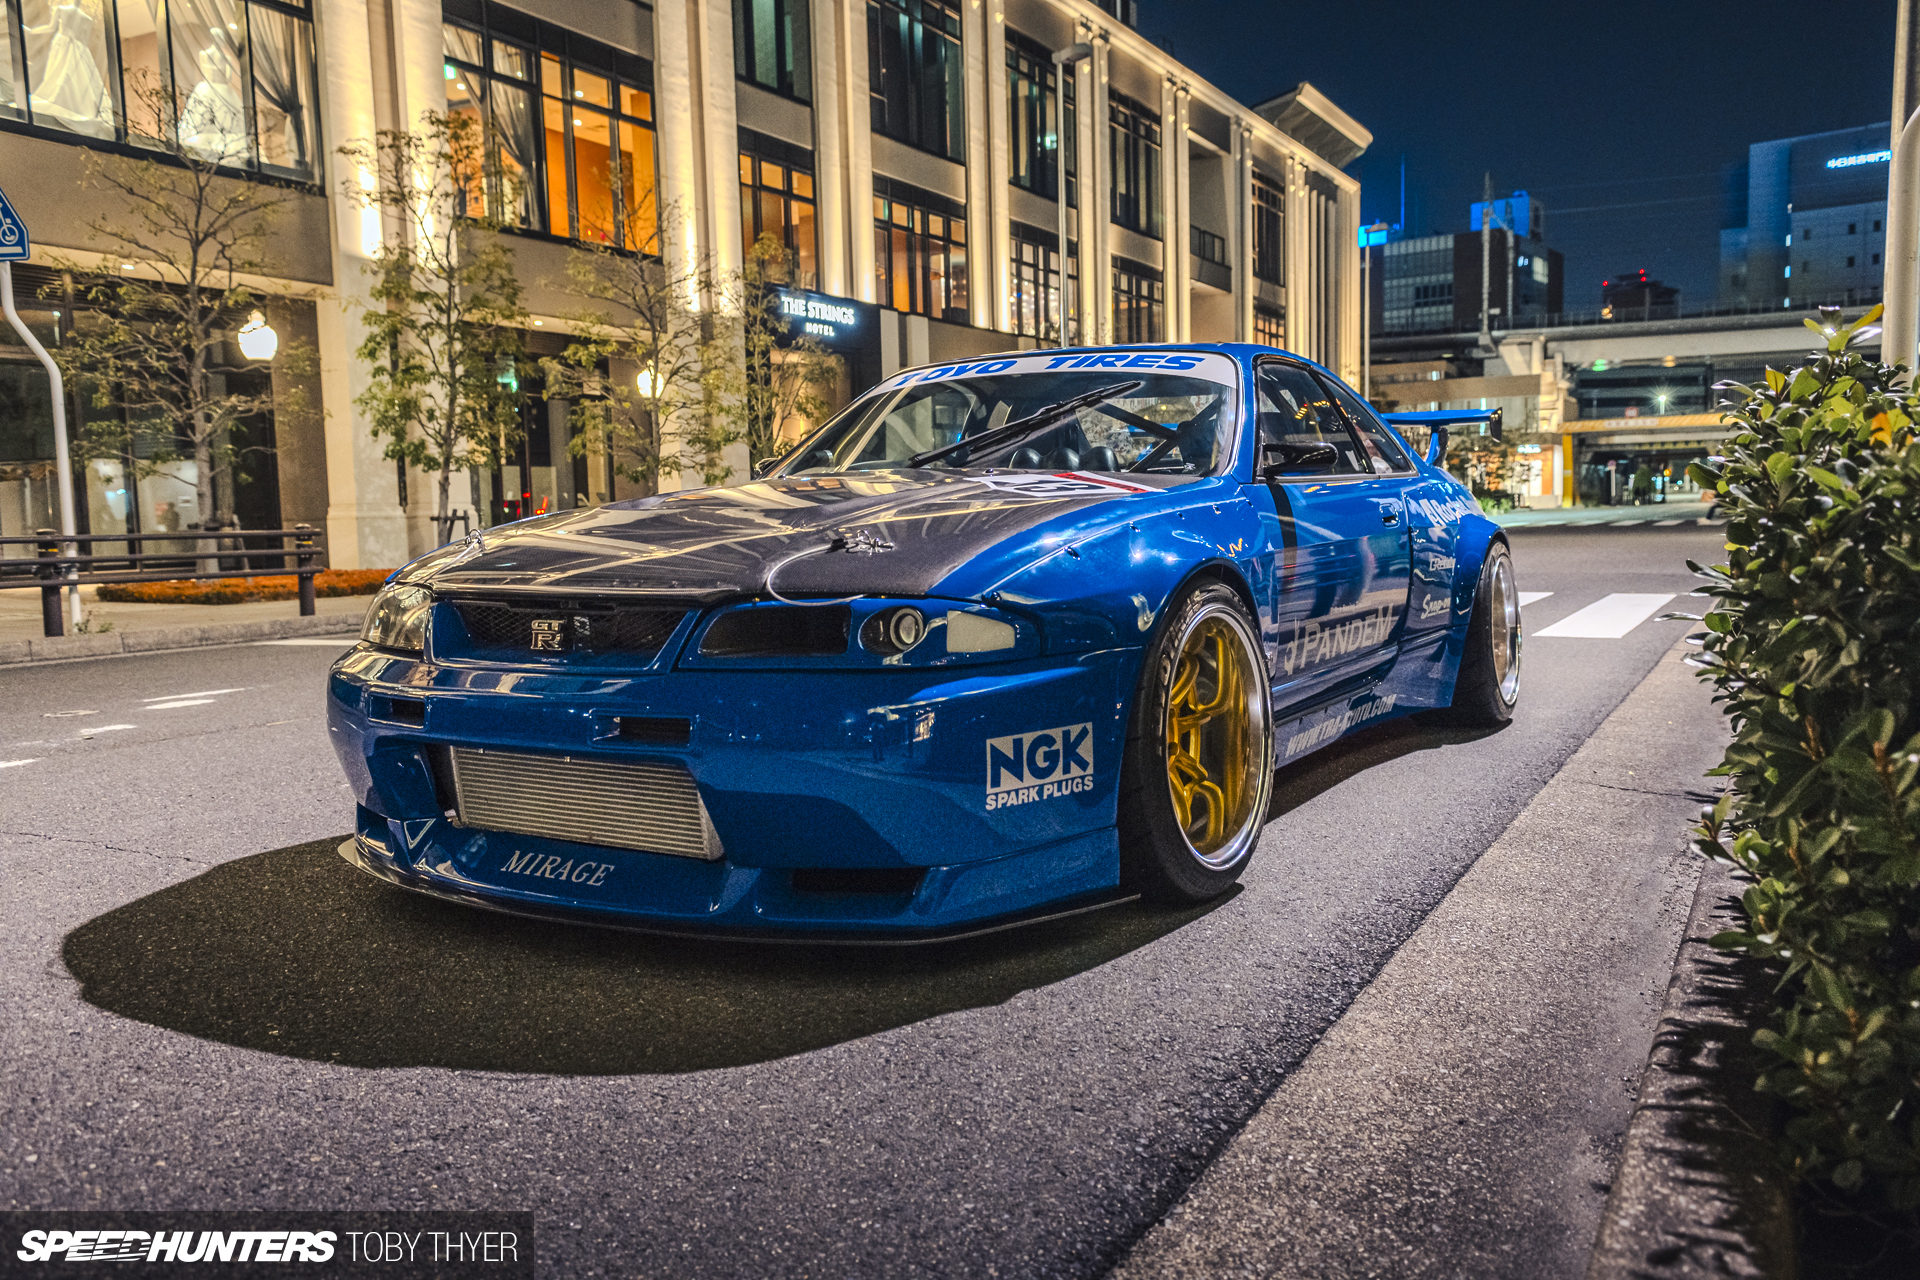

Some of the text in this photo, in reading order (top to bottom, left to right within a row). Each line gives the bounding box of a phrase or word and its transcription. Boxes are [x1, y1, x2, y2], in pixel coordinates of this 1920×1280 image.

[781, 296, 855, 324] THE STRINGS
[805, 322, 835, 337] HOTEL
[893, 354, 1206, 387] TOYO TIRES
[530, 630, 563, 650] R
[531, 619, 565, 631] GT
[989, 724, 1091, 790] NGK
[985, 776, 1094, 811] SPARK PLUGS
[500, 850, 615, 886] MIRAGE
